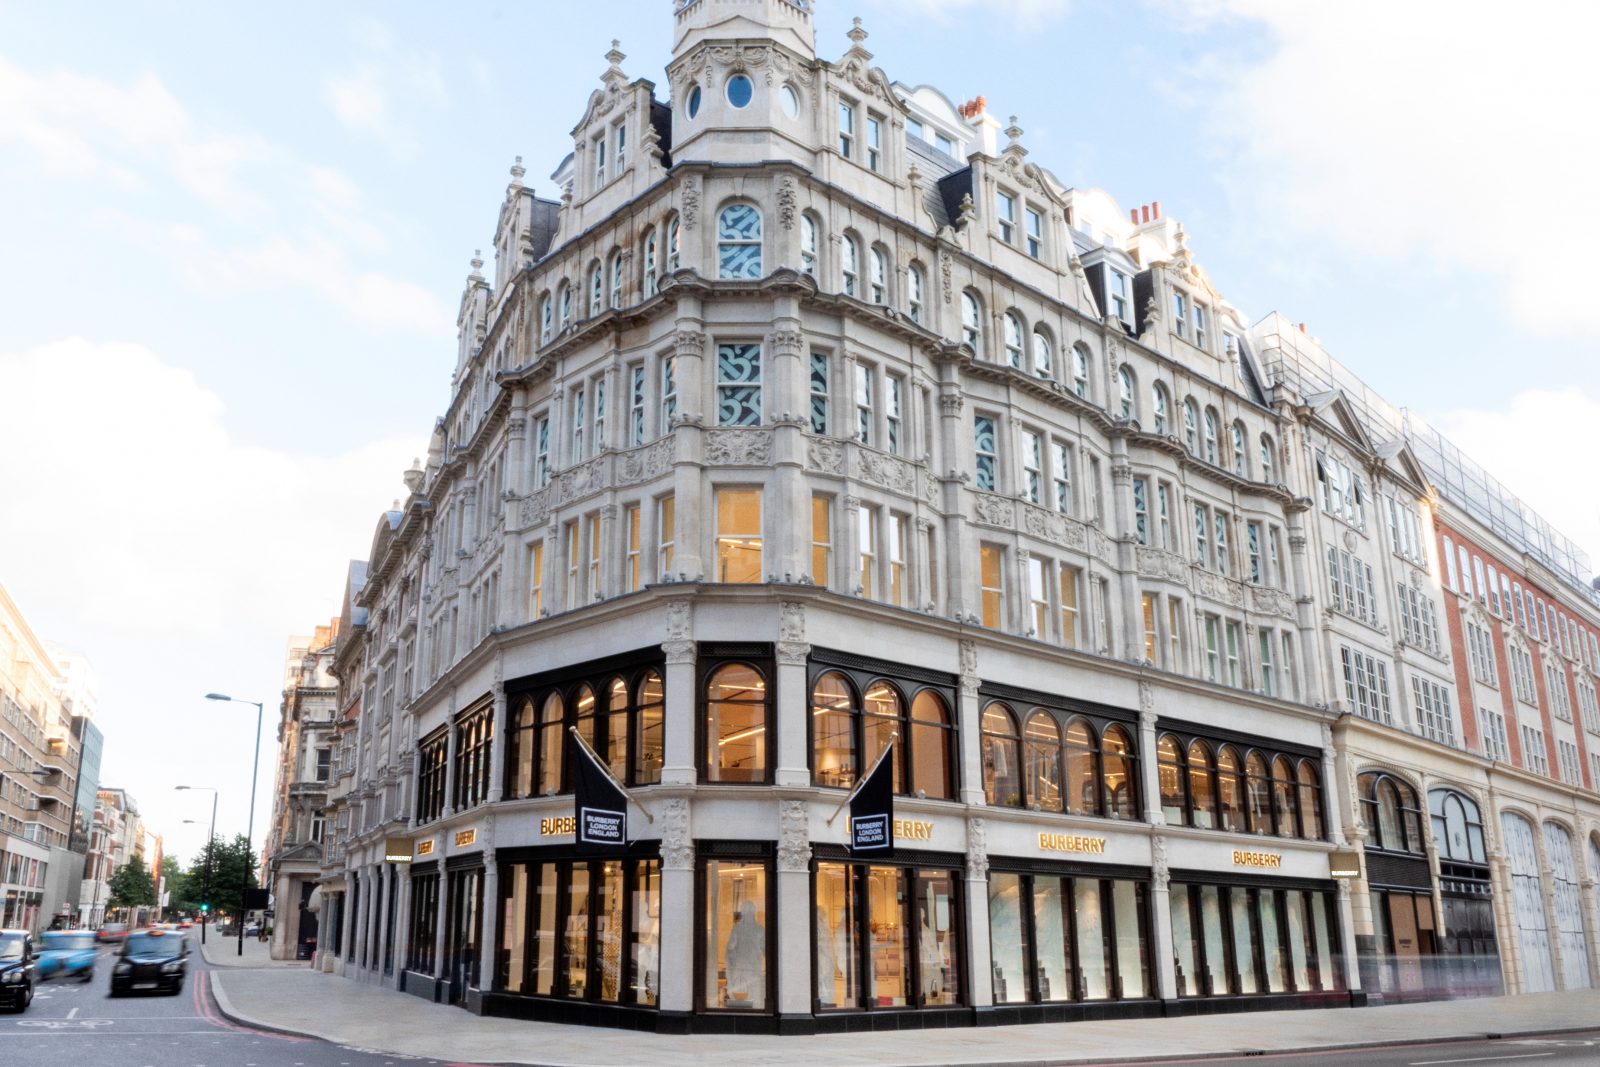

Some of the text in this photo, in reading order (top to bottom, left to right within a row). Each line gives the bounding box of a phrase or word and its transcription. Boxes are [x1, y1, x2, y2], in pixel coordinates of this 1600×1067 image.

[587, 815, 620, 825] BURBERRY
[541, 817, 576, 835] BURBE
[590, 822, 618, 831] LONDON
[856, 821, 883, 830] BURBERRY
[588, 828, 620, 838] ENGLAND
[858, 828, 882, 836] LONDON
[857, 834, 884, 843] ENGLAND
[1038, 831, 1106, 855] BURBERRY
[1232, 849, 1281, 869] BURBERRY
